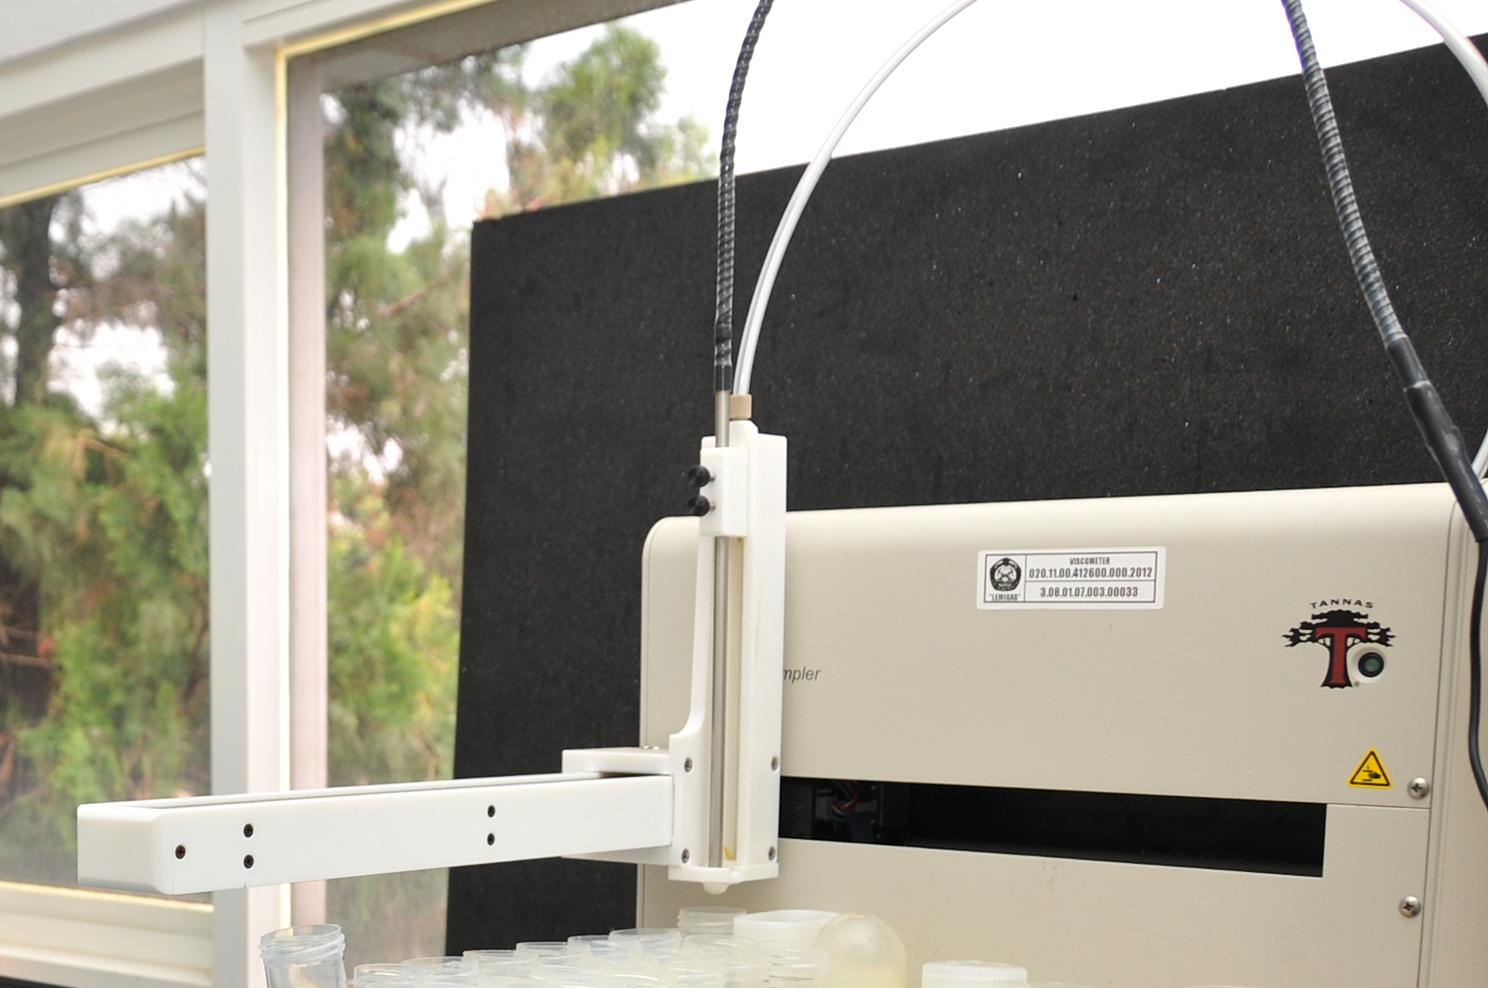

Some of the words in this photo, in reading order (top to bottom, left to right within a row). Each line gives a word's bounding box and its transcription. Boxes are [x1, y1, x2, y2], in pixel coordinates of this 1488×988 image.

[1069, 557, 1110, 565] VISCOMETER
[1029, 567, 1153, 579] 020.11.00.412600.000.2012
[1040, 586, 1138, 597] 3.08.01.07.003.00033
[1309, 598, 1374, 609] TANNAS
